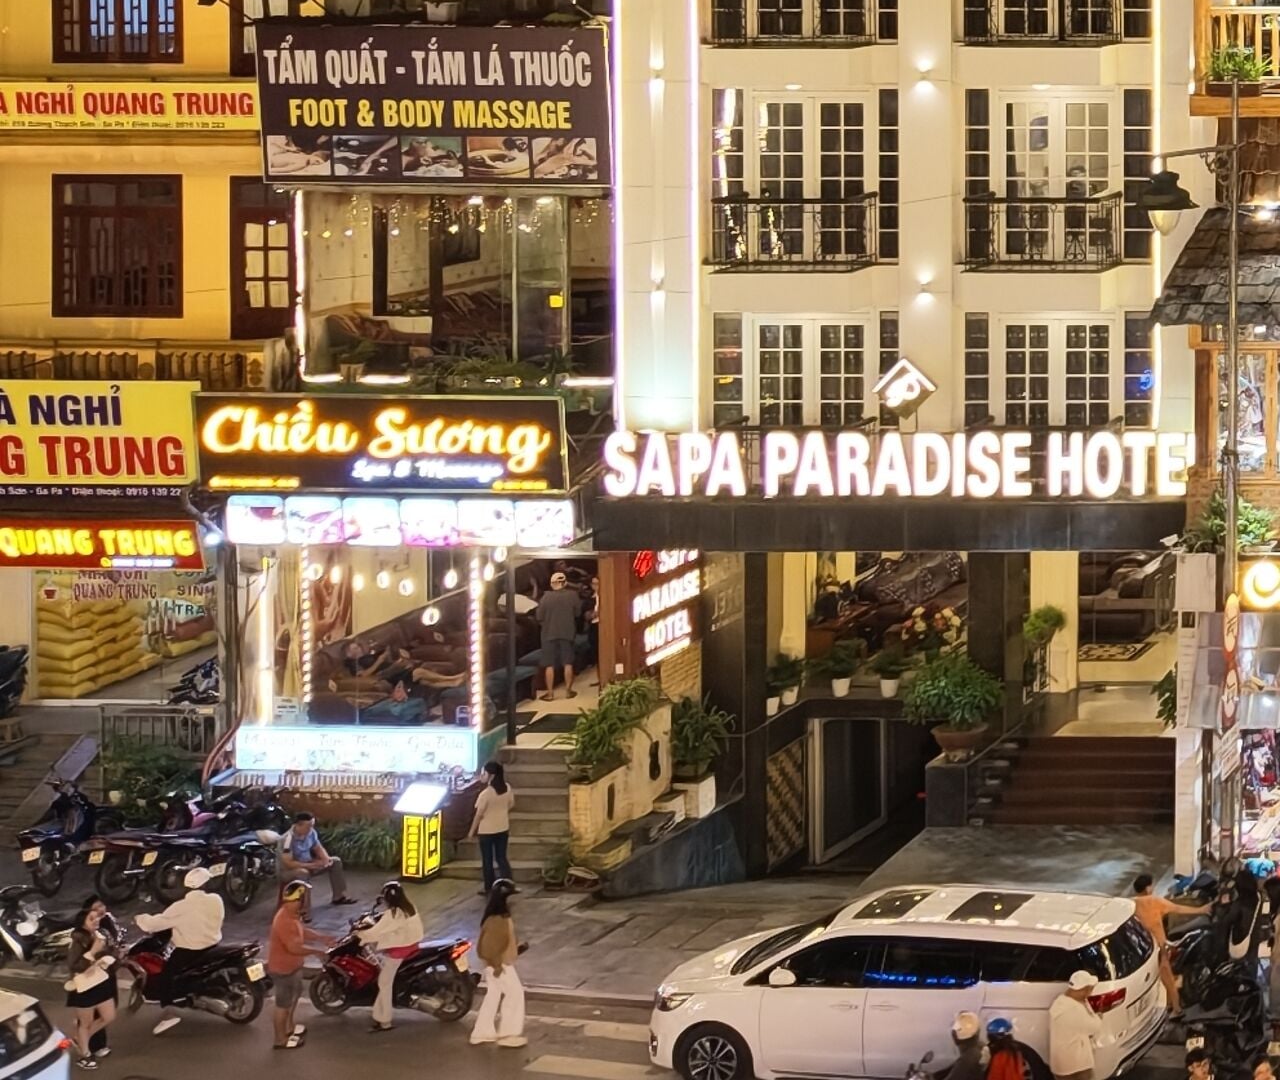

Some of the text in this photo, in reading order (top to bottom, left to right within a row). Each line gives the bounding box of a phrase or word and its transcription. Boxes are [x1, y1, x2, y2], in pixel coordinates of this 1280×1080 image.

[325, 37, 388, 88] QUẤT
[411, 37, 466, 86] TẮM
[473, 44, 505, 86] LÁ
[510, 39, 592, 88] THUỐC
[16, 84, 75, 115] NGHỈ
[83, 92, 165, 117] QUANG
[173, 92, 254, 116] TRUNG
[289, 99, 572, 129] FOOT & BODY MASSAGE
[29, 384, 122, 426] NGHỈ
[39, 436, 186, 476] TRUNG
[202, 399, 550, 474] Chiều Sương
[603, 430, 746, 498] SAPA
[763, 431, 1033, 498] PARADISE
[0, 528, 196, 557] QUANG TRUNG
[74, 583, 157, 600] QUANG TRUNG
[632, 568, 700, 623] PARADISE
[644, 608, 692, 653] HOTEL
